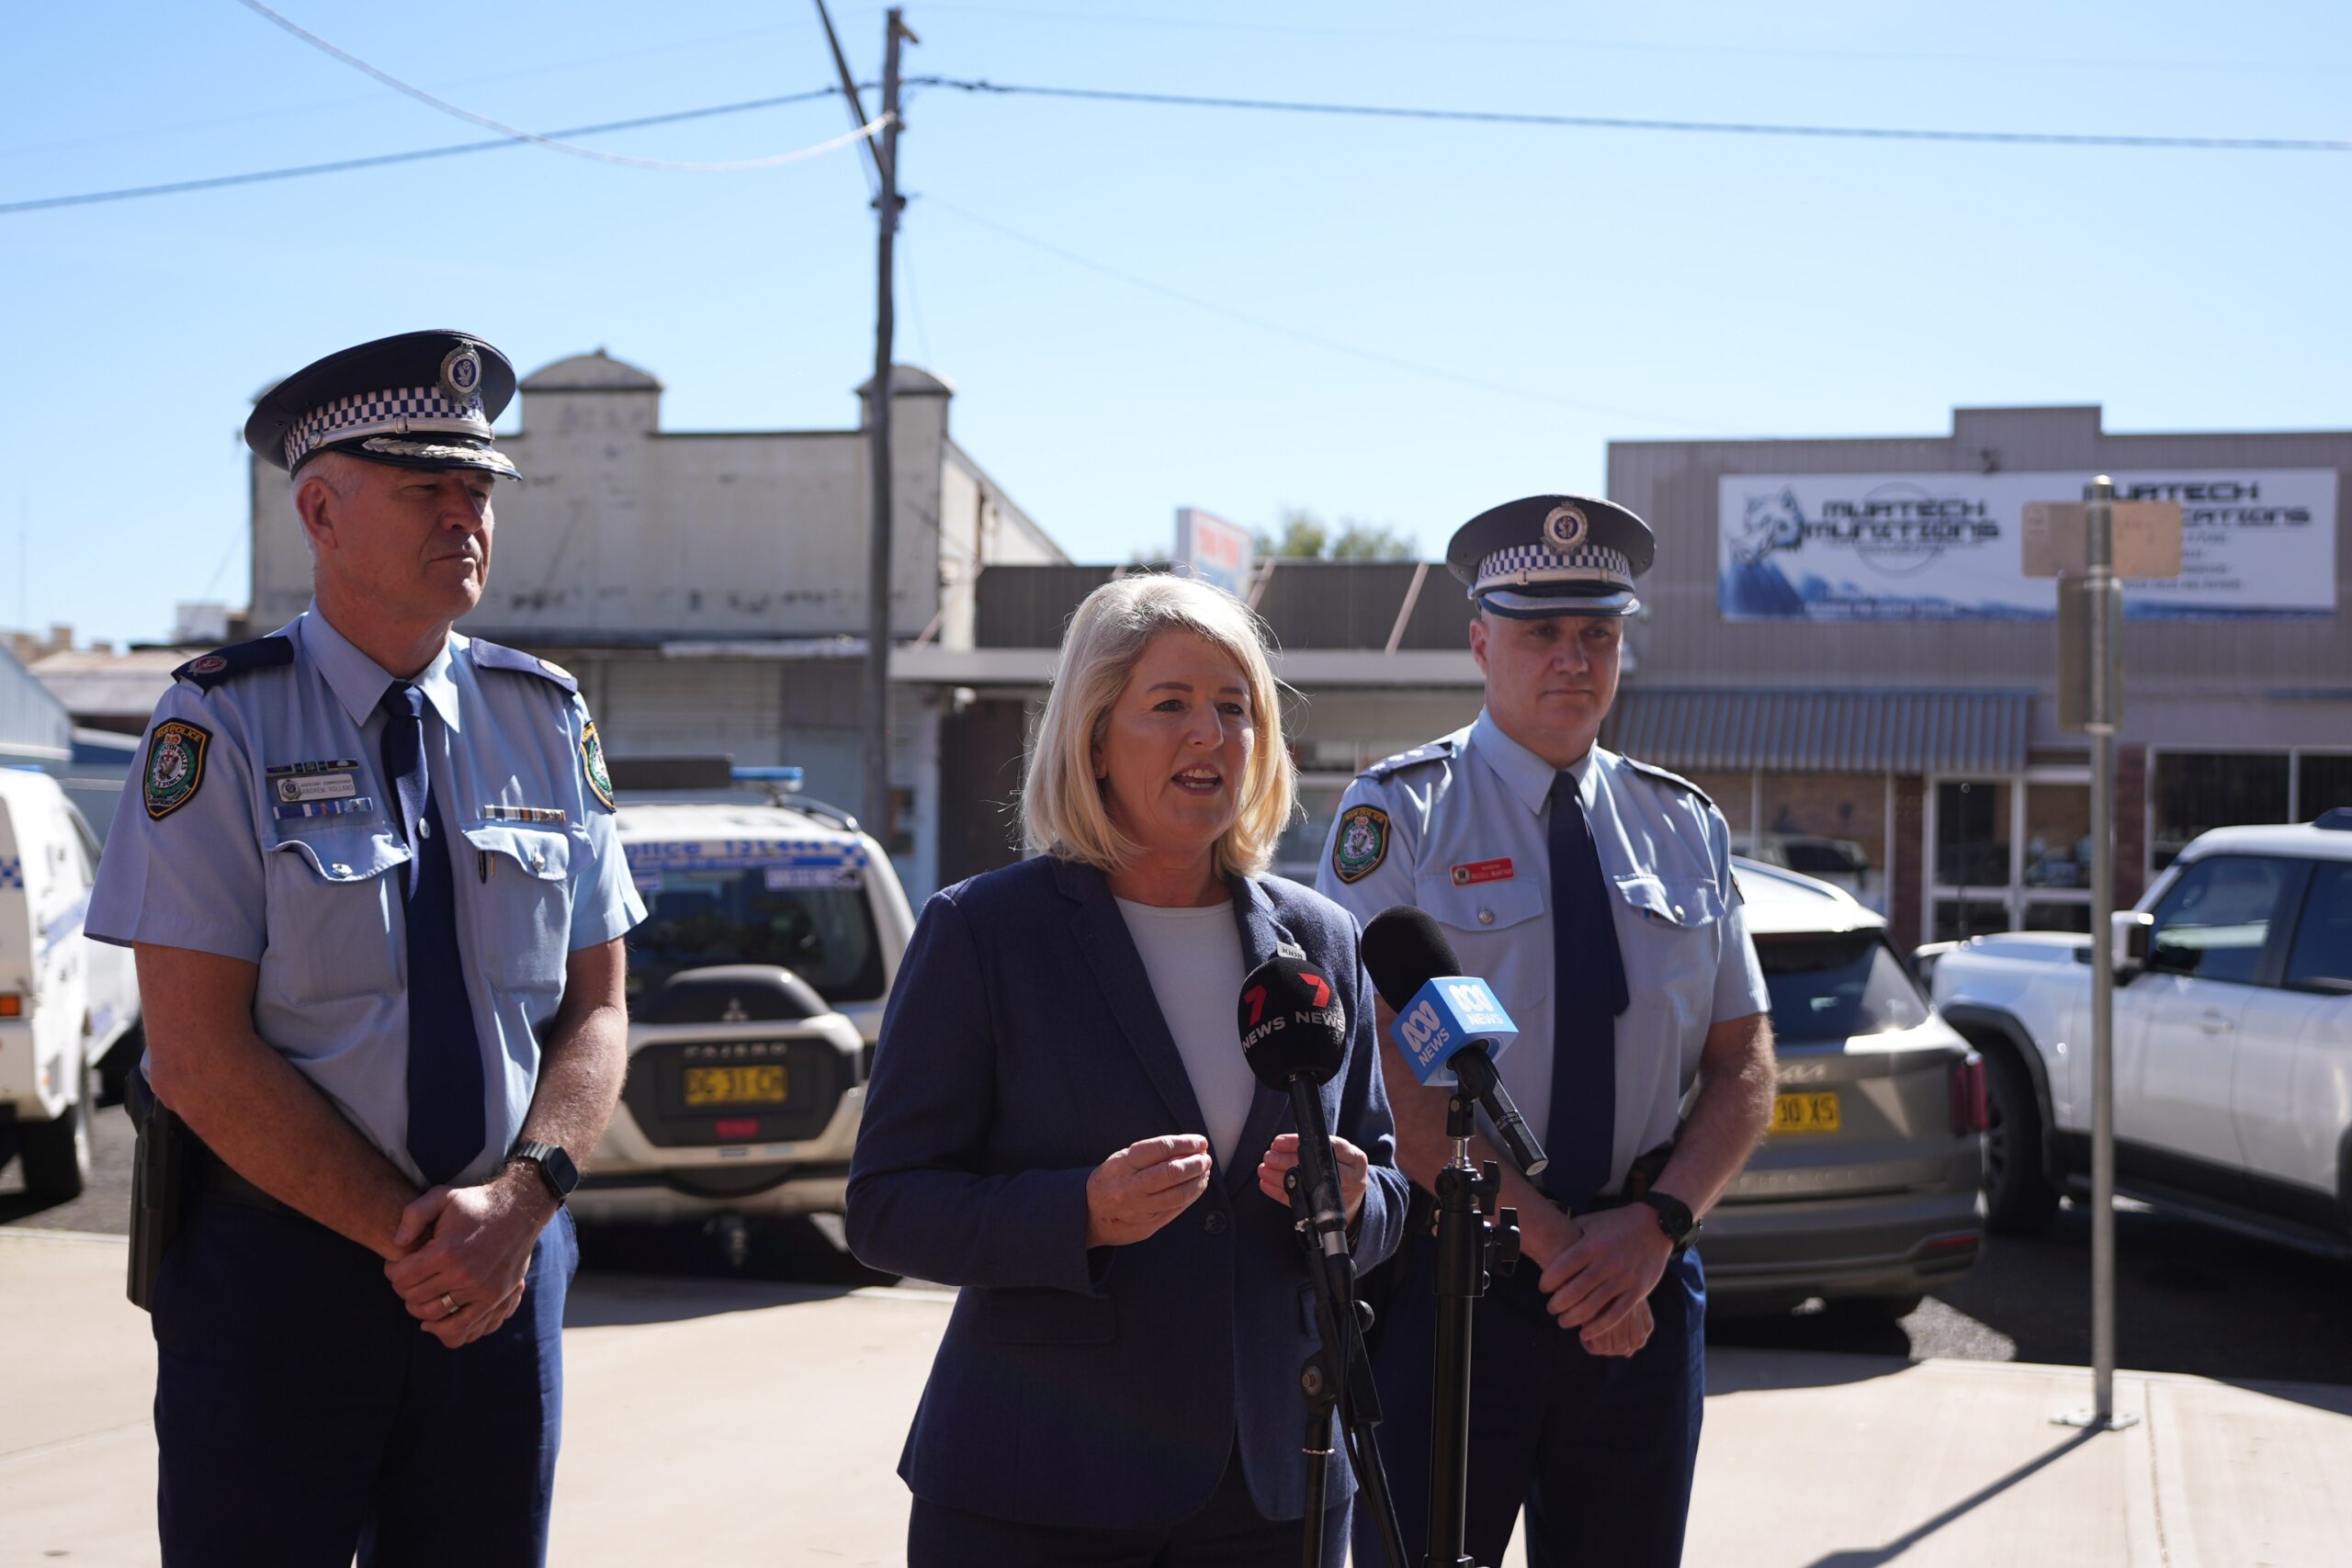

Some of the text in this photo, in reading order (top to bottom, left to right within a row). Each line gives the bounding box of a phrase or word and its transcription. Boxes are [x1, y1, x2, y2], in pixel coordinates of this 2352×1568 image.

[169, 725, 202, 742] POLICE
[328, 784, 354, 793] HOLLAND
[624, 840, 700, 855] olice
[1295, 1010, 1345, 1032] NEWS
[1465, 1013, 1504, 1026] NEWS
[1241, 1016, 1286, 1053] NEWS
[1418, 1028, 1450, 1066] NEWS
